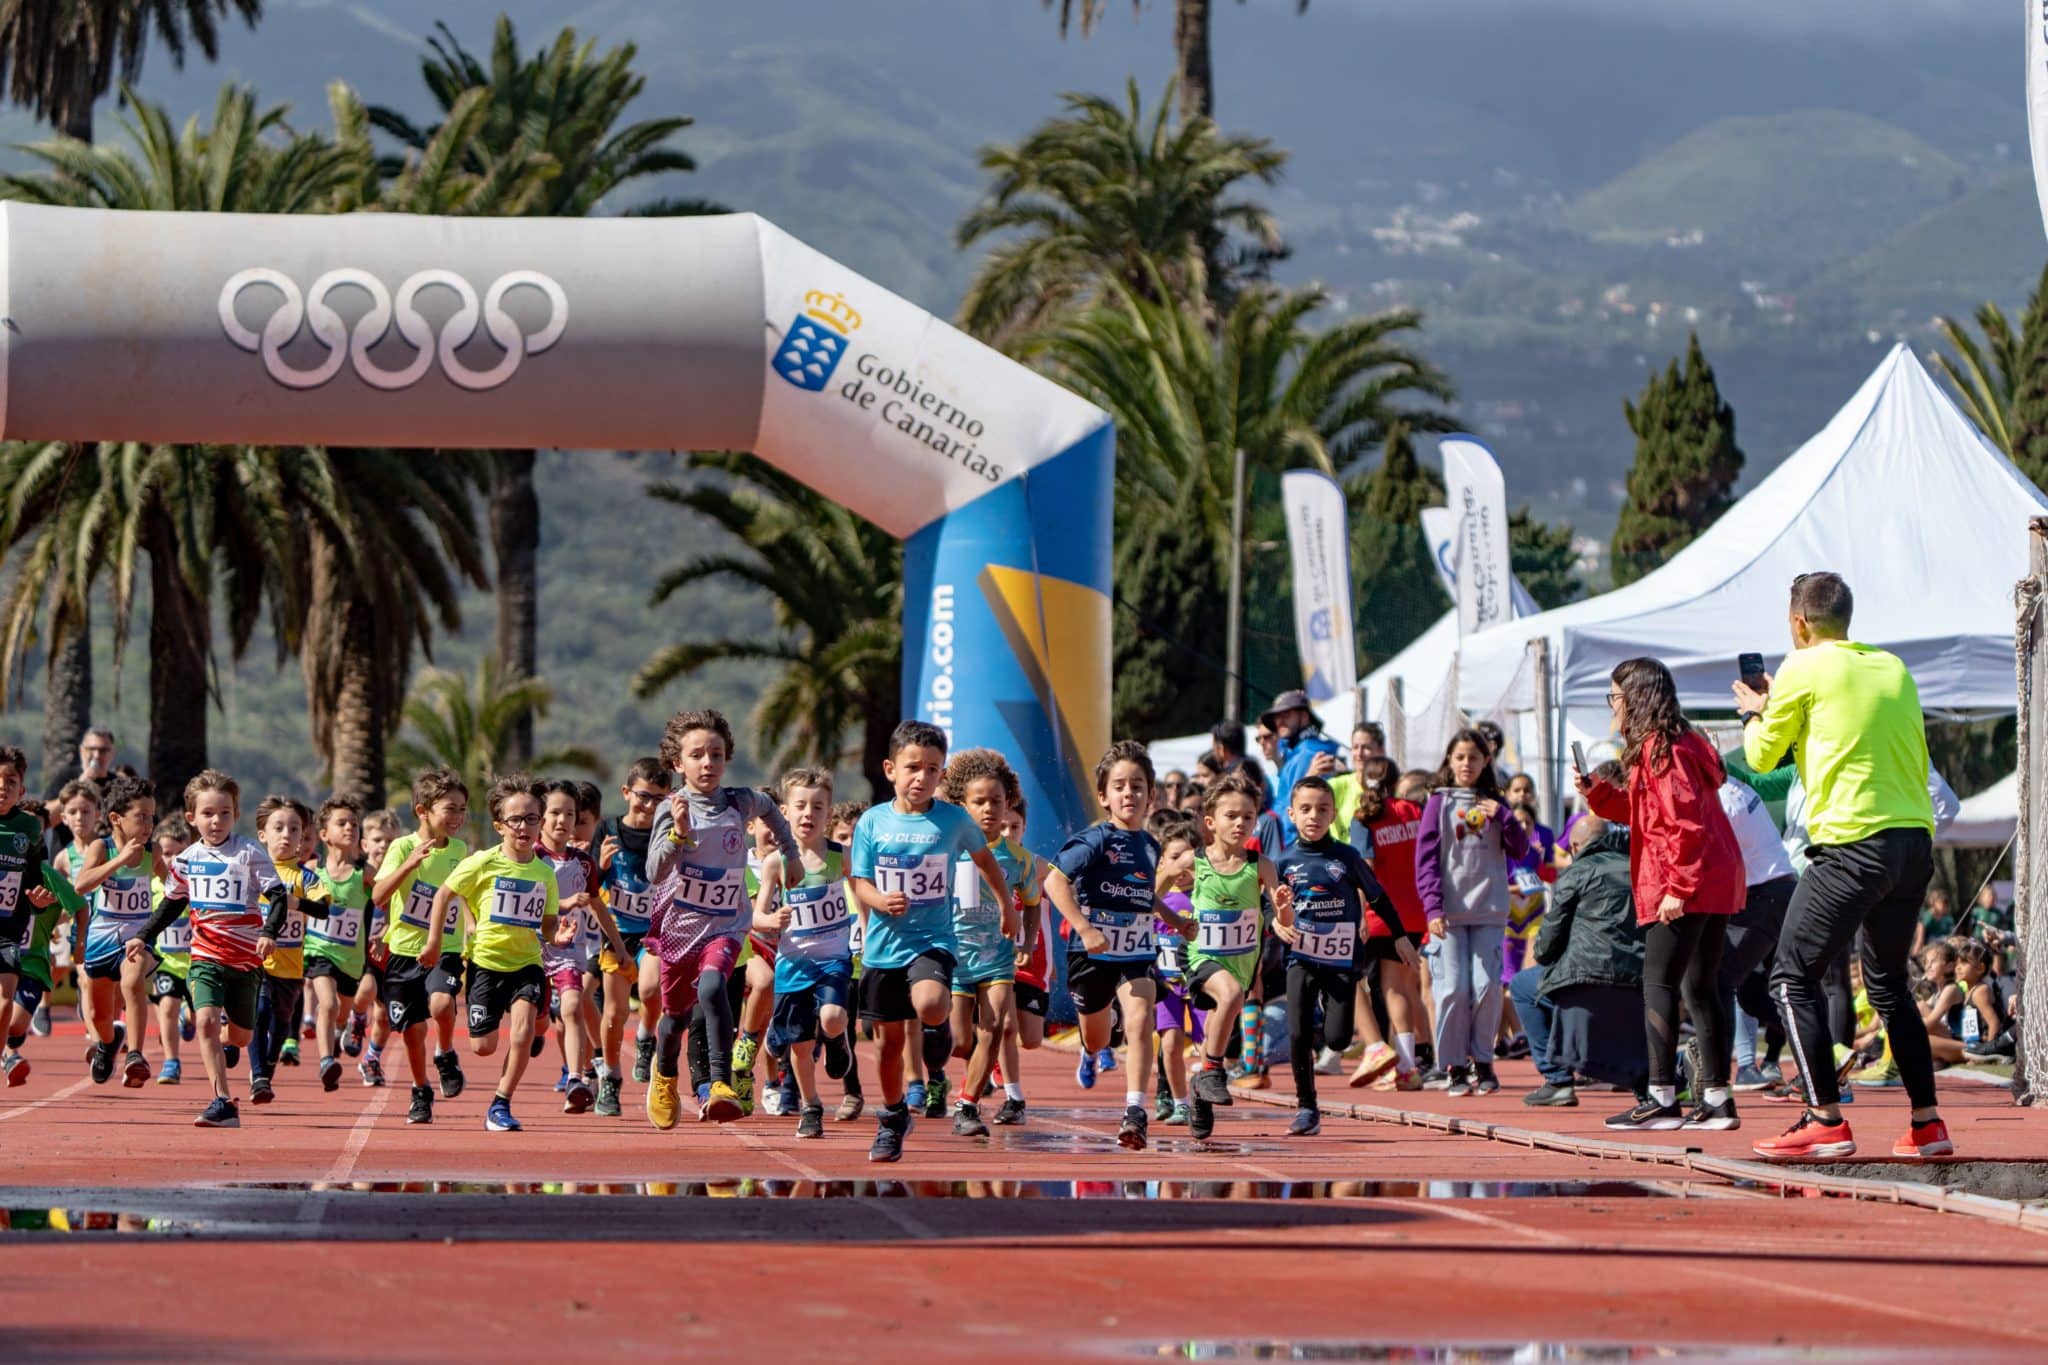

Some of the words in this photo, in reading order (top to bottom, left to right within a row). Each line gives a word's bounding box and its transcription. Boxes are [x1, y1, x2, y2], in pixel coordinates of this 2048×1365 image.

[856, 353, 984, 438] Gobierno
[841, 380, 876, 410] de
[882, 400, 1003, 482] Canarias
[926, 584, 954, 768] rio.com
[190, 878, 242, 900] 1131
[682, 878, 739, 906] 1137
[878, 869, 945, 896] 1134
[103, 889, 149, 910] 1108
[410, 894, 458, 925] 113
[497, 892, 545, 919] 1148
[611, 888, 649, 914] 115
[792, 896, 847, 926] 1109
[1292, 898, 1345, 912] ajaCanarias
[1095, 926, 1152, 953] 154
[1202, 923, 1256, 946] 1112
[1297, 933, 1352, 956] 1155
